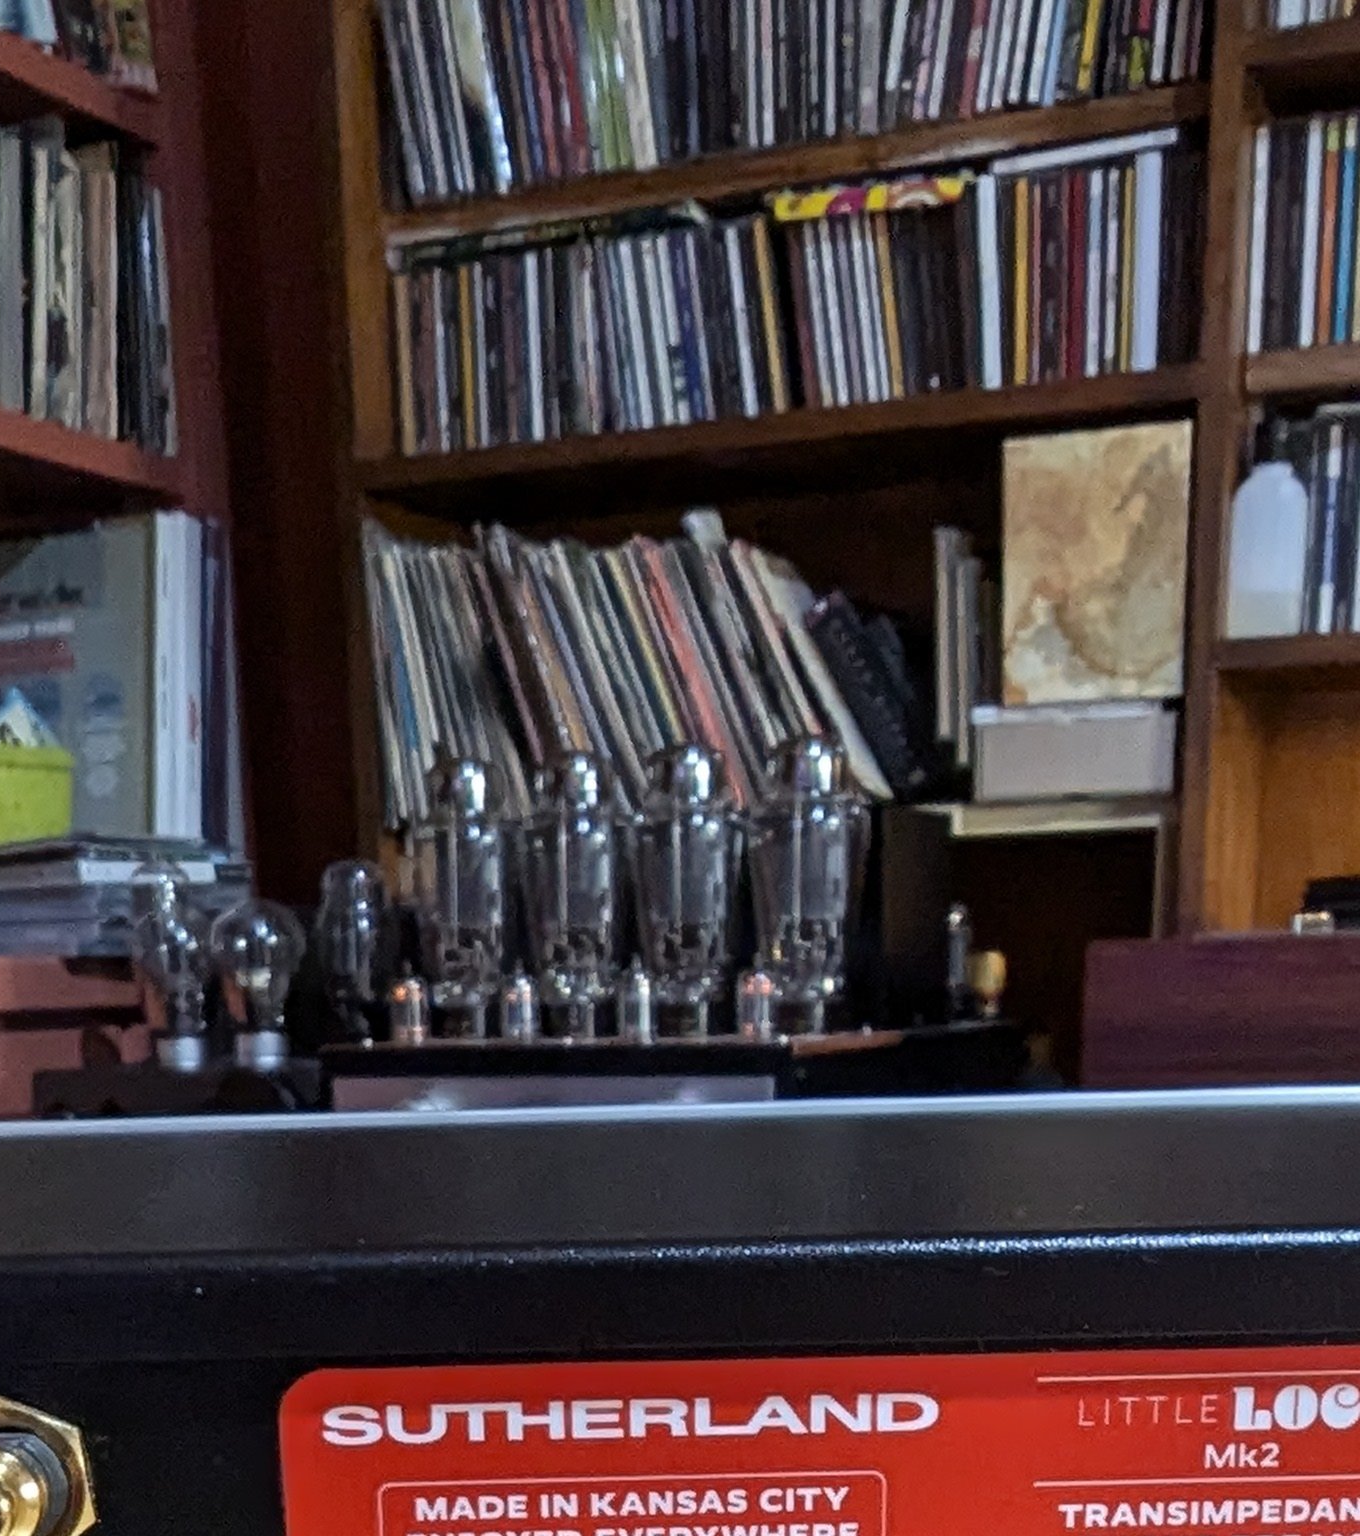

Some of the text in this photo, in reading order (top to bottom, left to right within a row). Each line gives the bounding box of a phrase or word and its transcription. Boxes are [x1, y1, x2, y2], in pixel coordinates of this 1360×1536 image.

[323, 1394, 938, 1445] SUTHERLAND
[1078, 1395, 1218, 1427] LITTLE
[1204, 1443, 1280, 1469] Mk2
[415, 1487, 849, 1522] MADE IN KANSAS CITY
